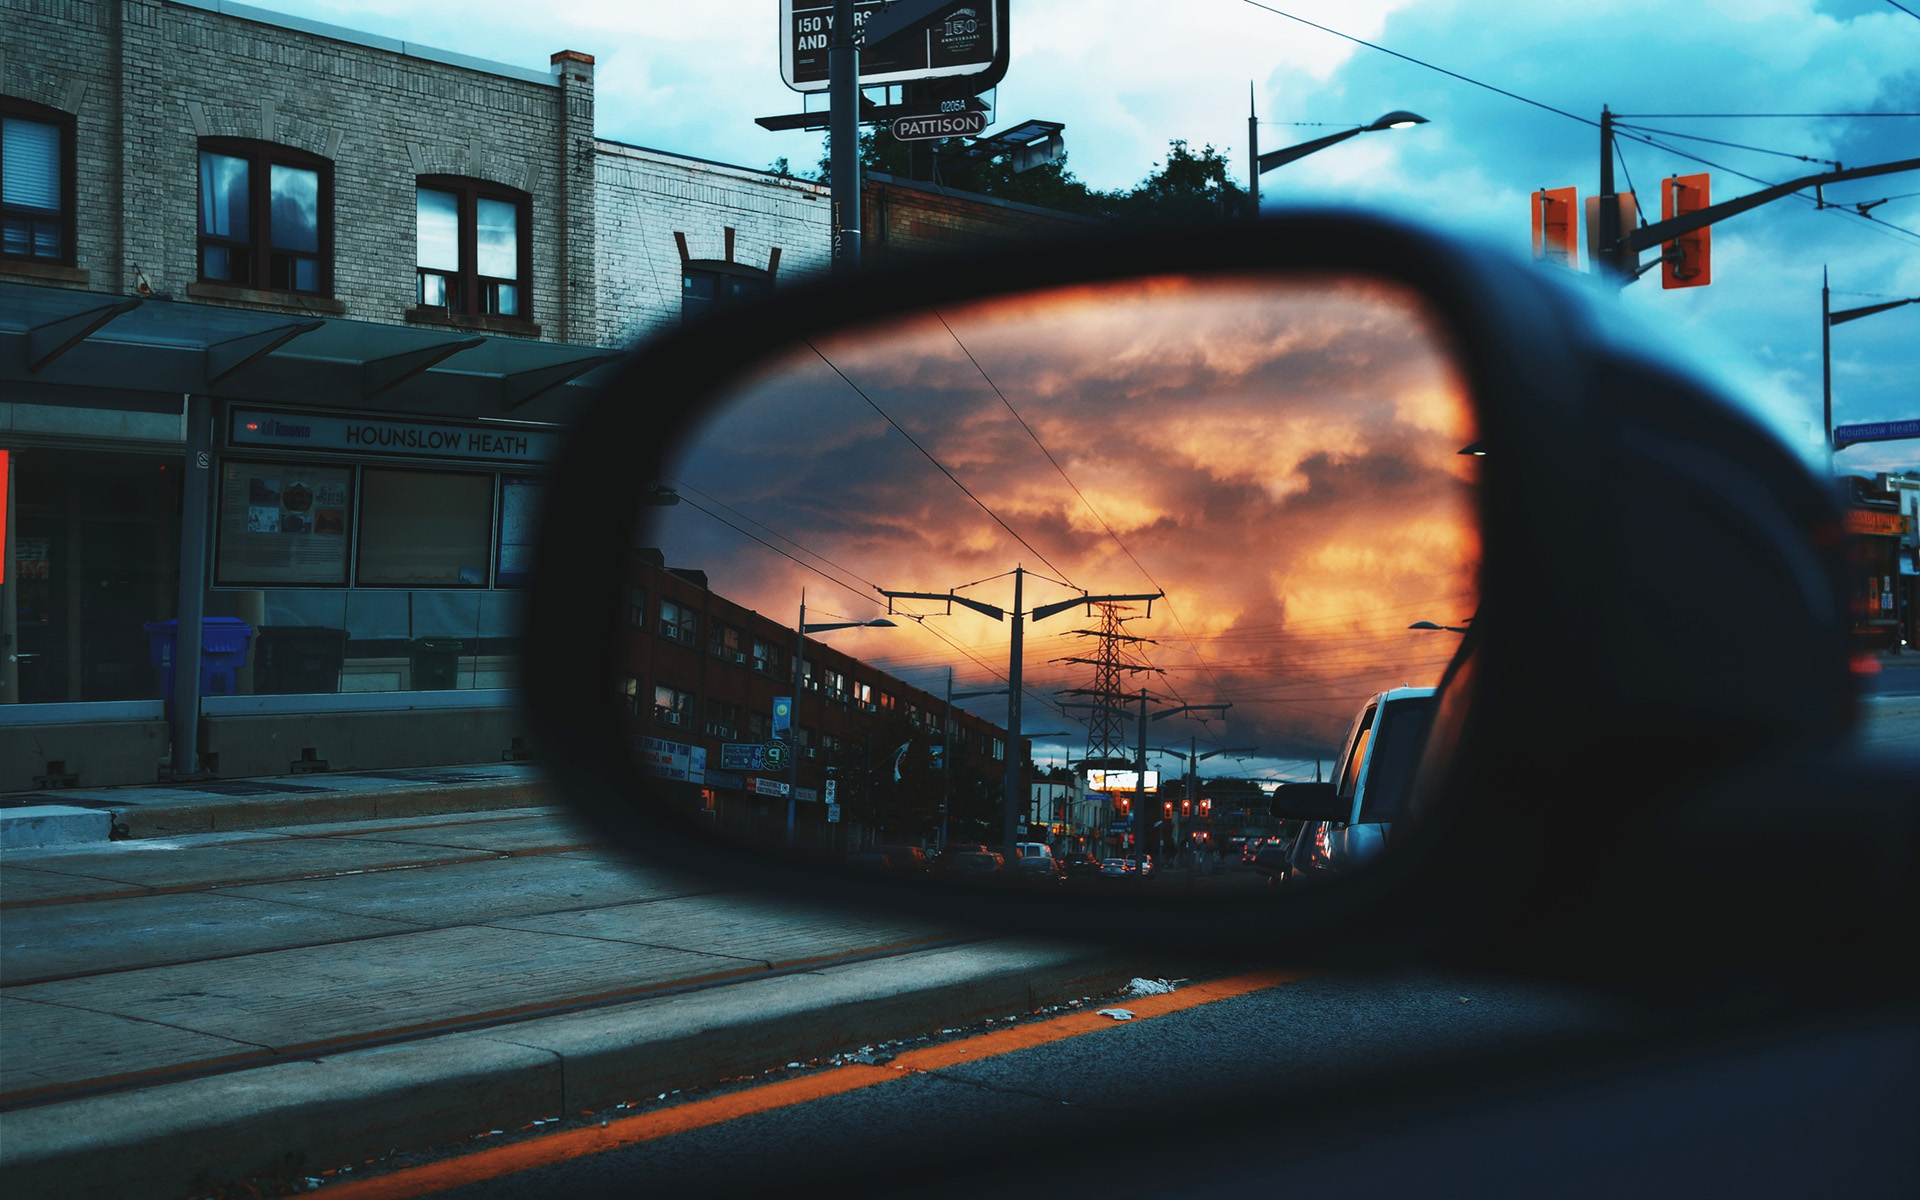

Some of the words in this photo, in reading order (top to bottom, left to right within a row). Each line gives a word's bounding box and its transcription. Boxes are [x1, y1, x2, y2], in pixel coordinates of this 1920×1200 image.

[798, 16, 822, 33] 150
[825, 10, 872, 30] YRS
[944, 19, 978, 36] 150
[797, 33, 828, 51] AND
[941, 99, 966, 112] 0205A
[900, 116, 979, 136] PATTISON
[275, 422, 311, 438] TORONTO
[1839, 425, 1886, 438] Hounslow
[1889, 422, 1919, 434] Heath
[346, 425, 462, 450] HOUNSLOW
[468, 434, 528, 455] HEATH
